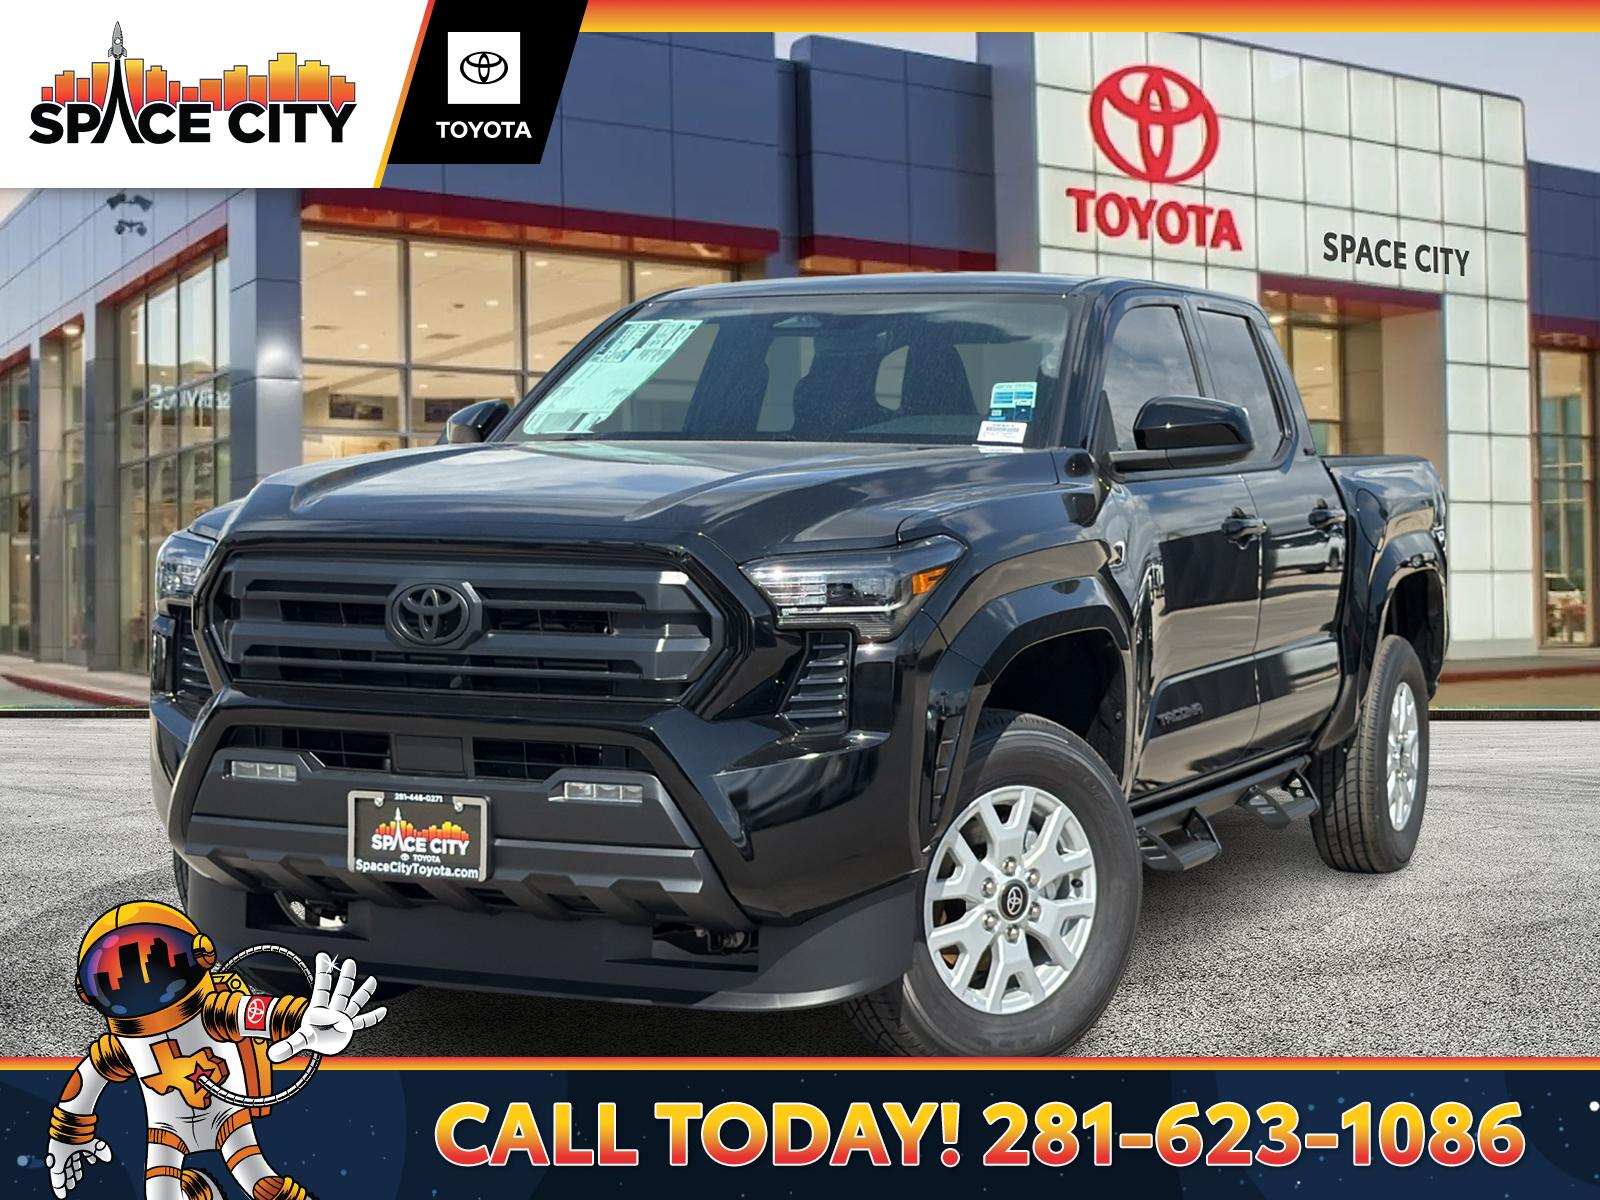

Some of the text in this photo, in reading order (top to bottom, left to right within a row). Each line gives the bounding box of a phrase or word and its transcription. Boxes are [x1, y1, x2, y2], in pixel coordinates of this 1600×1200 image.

[1066, 188, 1242, 251] TOYOTA
[1323, 231, 1470, 277] SPACE CITY
[371, 829, 470, 856] SPACE CITY
[355, 858, 480, 879] SpaceCityToyota.com
[412, 853, 441, 864] TOYOTA
